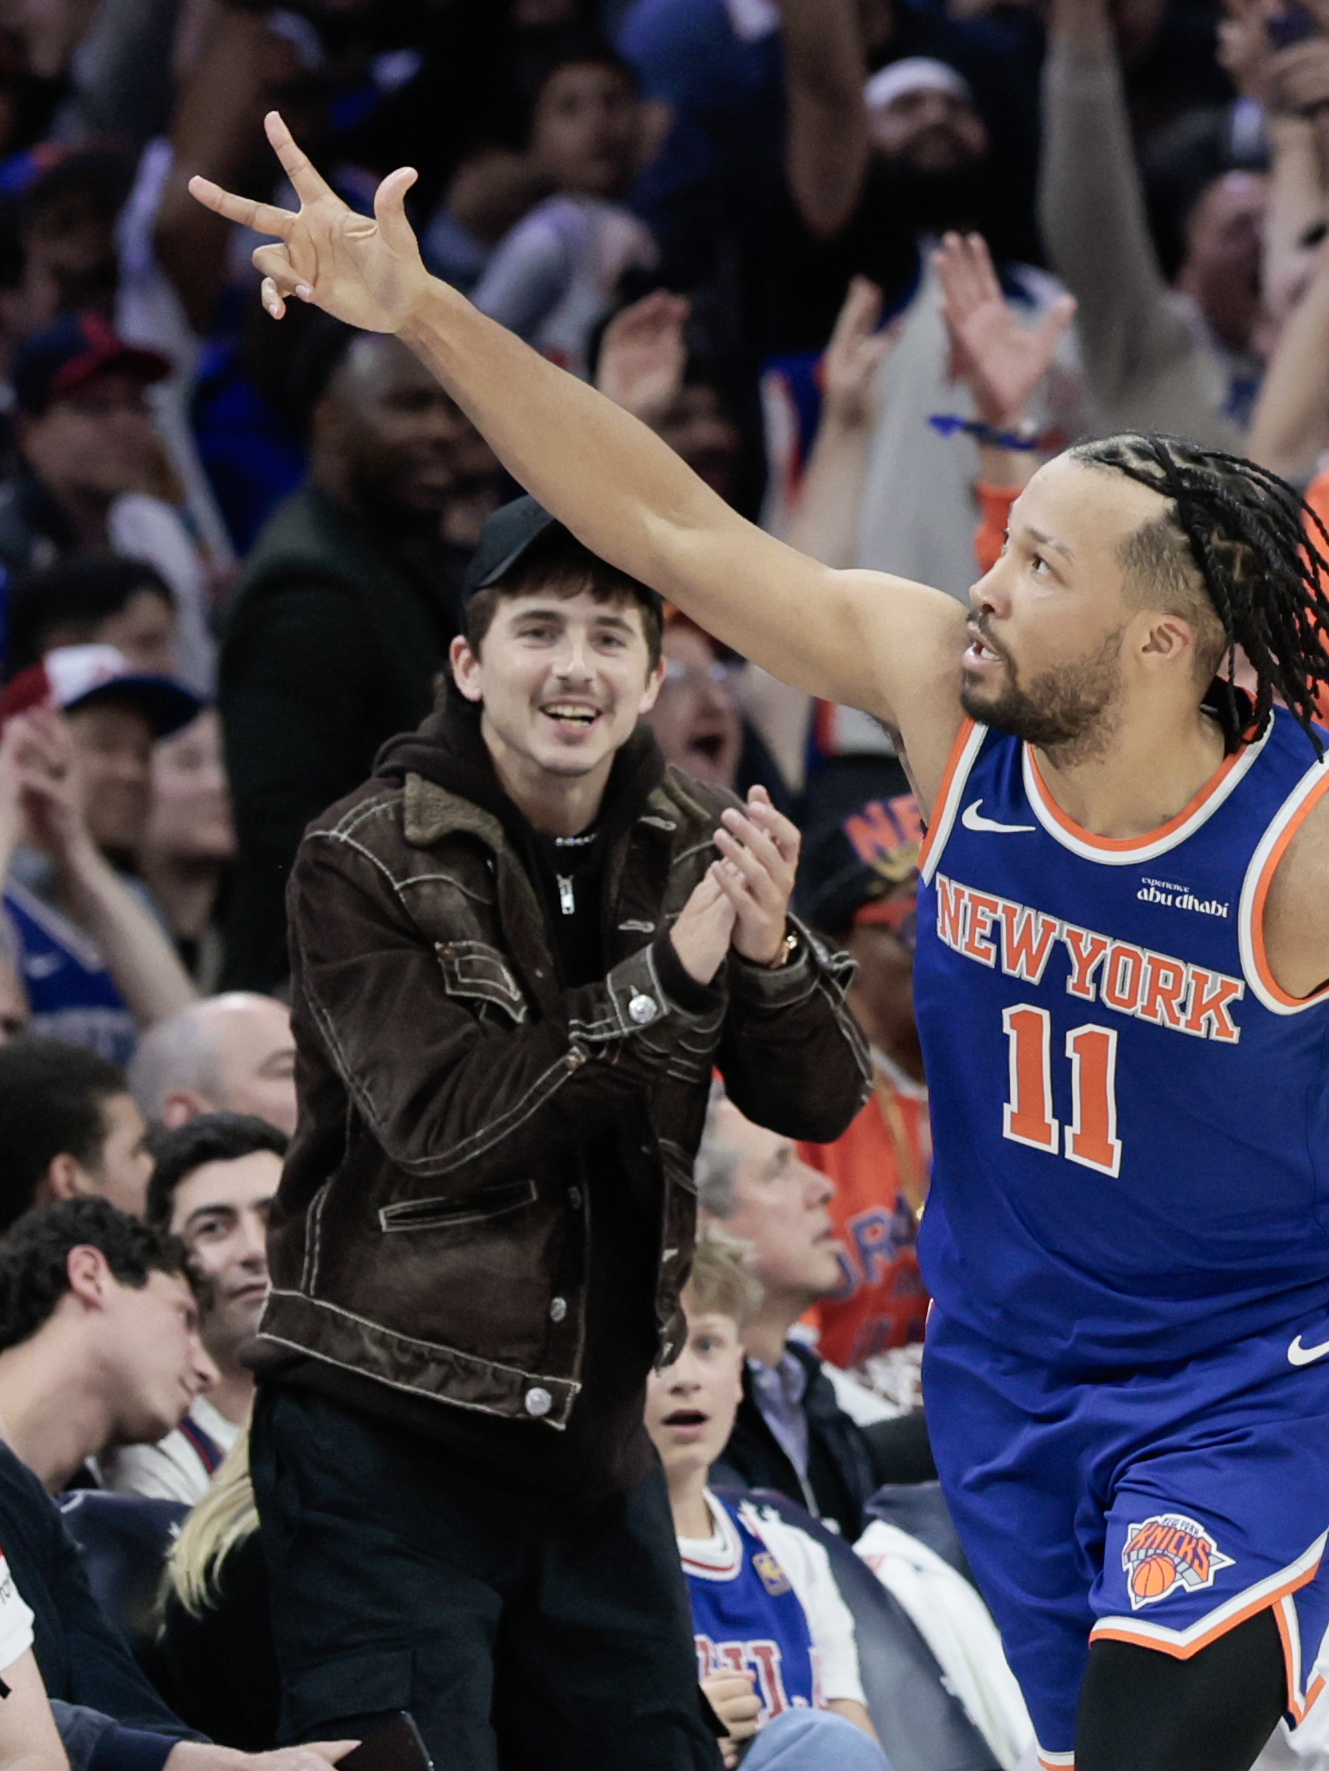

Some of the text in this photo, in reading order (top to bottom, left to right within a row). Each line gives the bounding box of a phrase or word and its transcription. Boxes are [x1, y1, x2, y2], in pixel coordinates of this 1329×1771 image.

[1136, 886, 1230, 919] abu dhabi
[1141, 876, 1191, 893] experience
[935, 871, 1246, 1045] NEW YORK
[1001, 1002, 1123, 1179] 11
[1123, 1520, 1213, 1583] KNICKS
